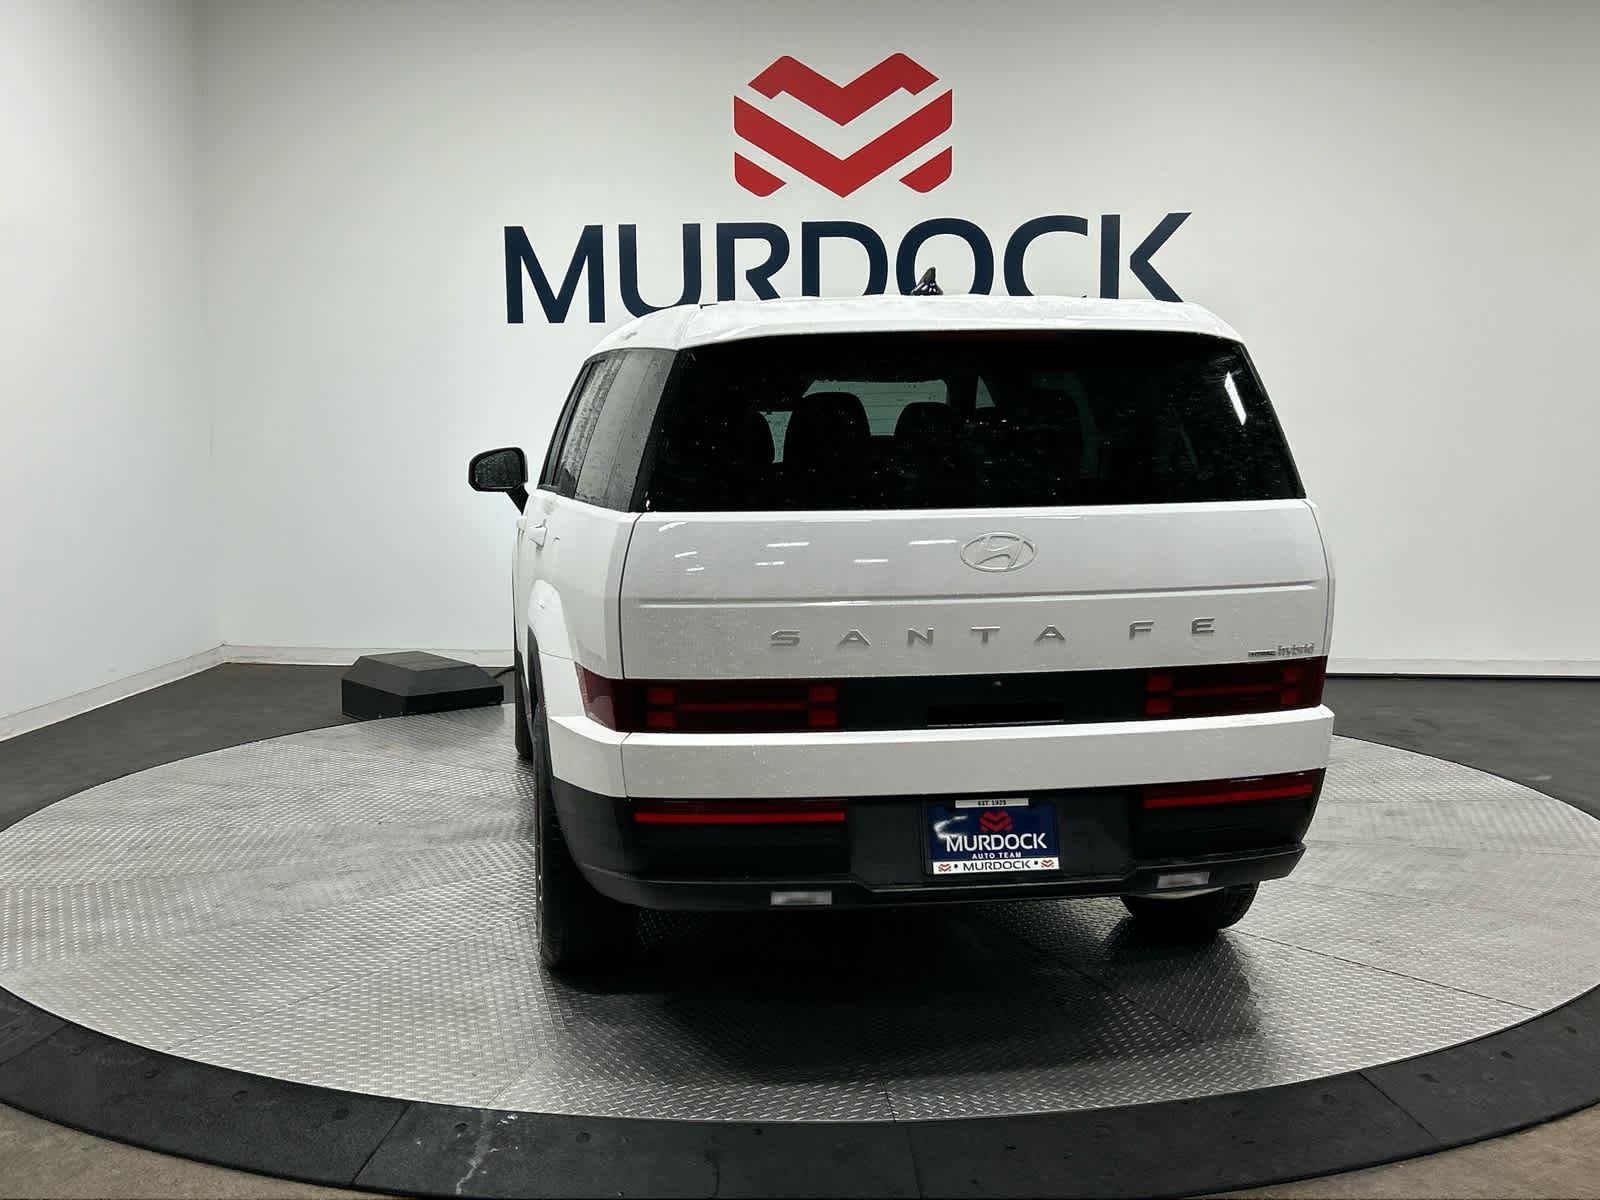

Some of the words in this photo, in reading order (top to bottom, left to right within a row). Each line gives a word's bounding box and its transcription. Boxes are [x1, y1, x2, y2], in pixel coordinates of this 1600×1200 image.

[504, 212, 1191, 323] MURDOCK
[769, 624, 1066, 647] SANTA
[1129, 616, 1216, 640] FE
[946, 833, 1047, 852] MURDOCK
[999, 851, 1022, 859] TEAM
[963, 860, 1031, 871] MURDOCK
